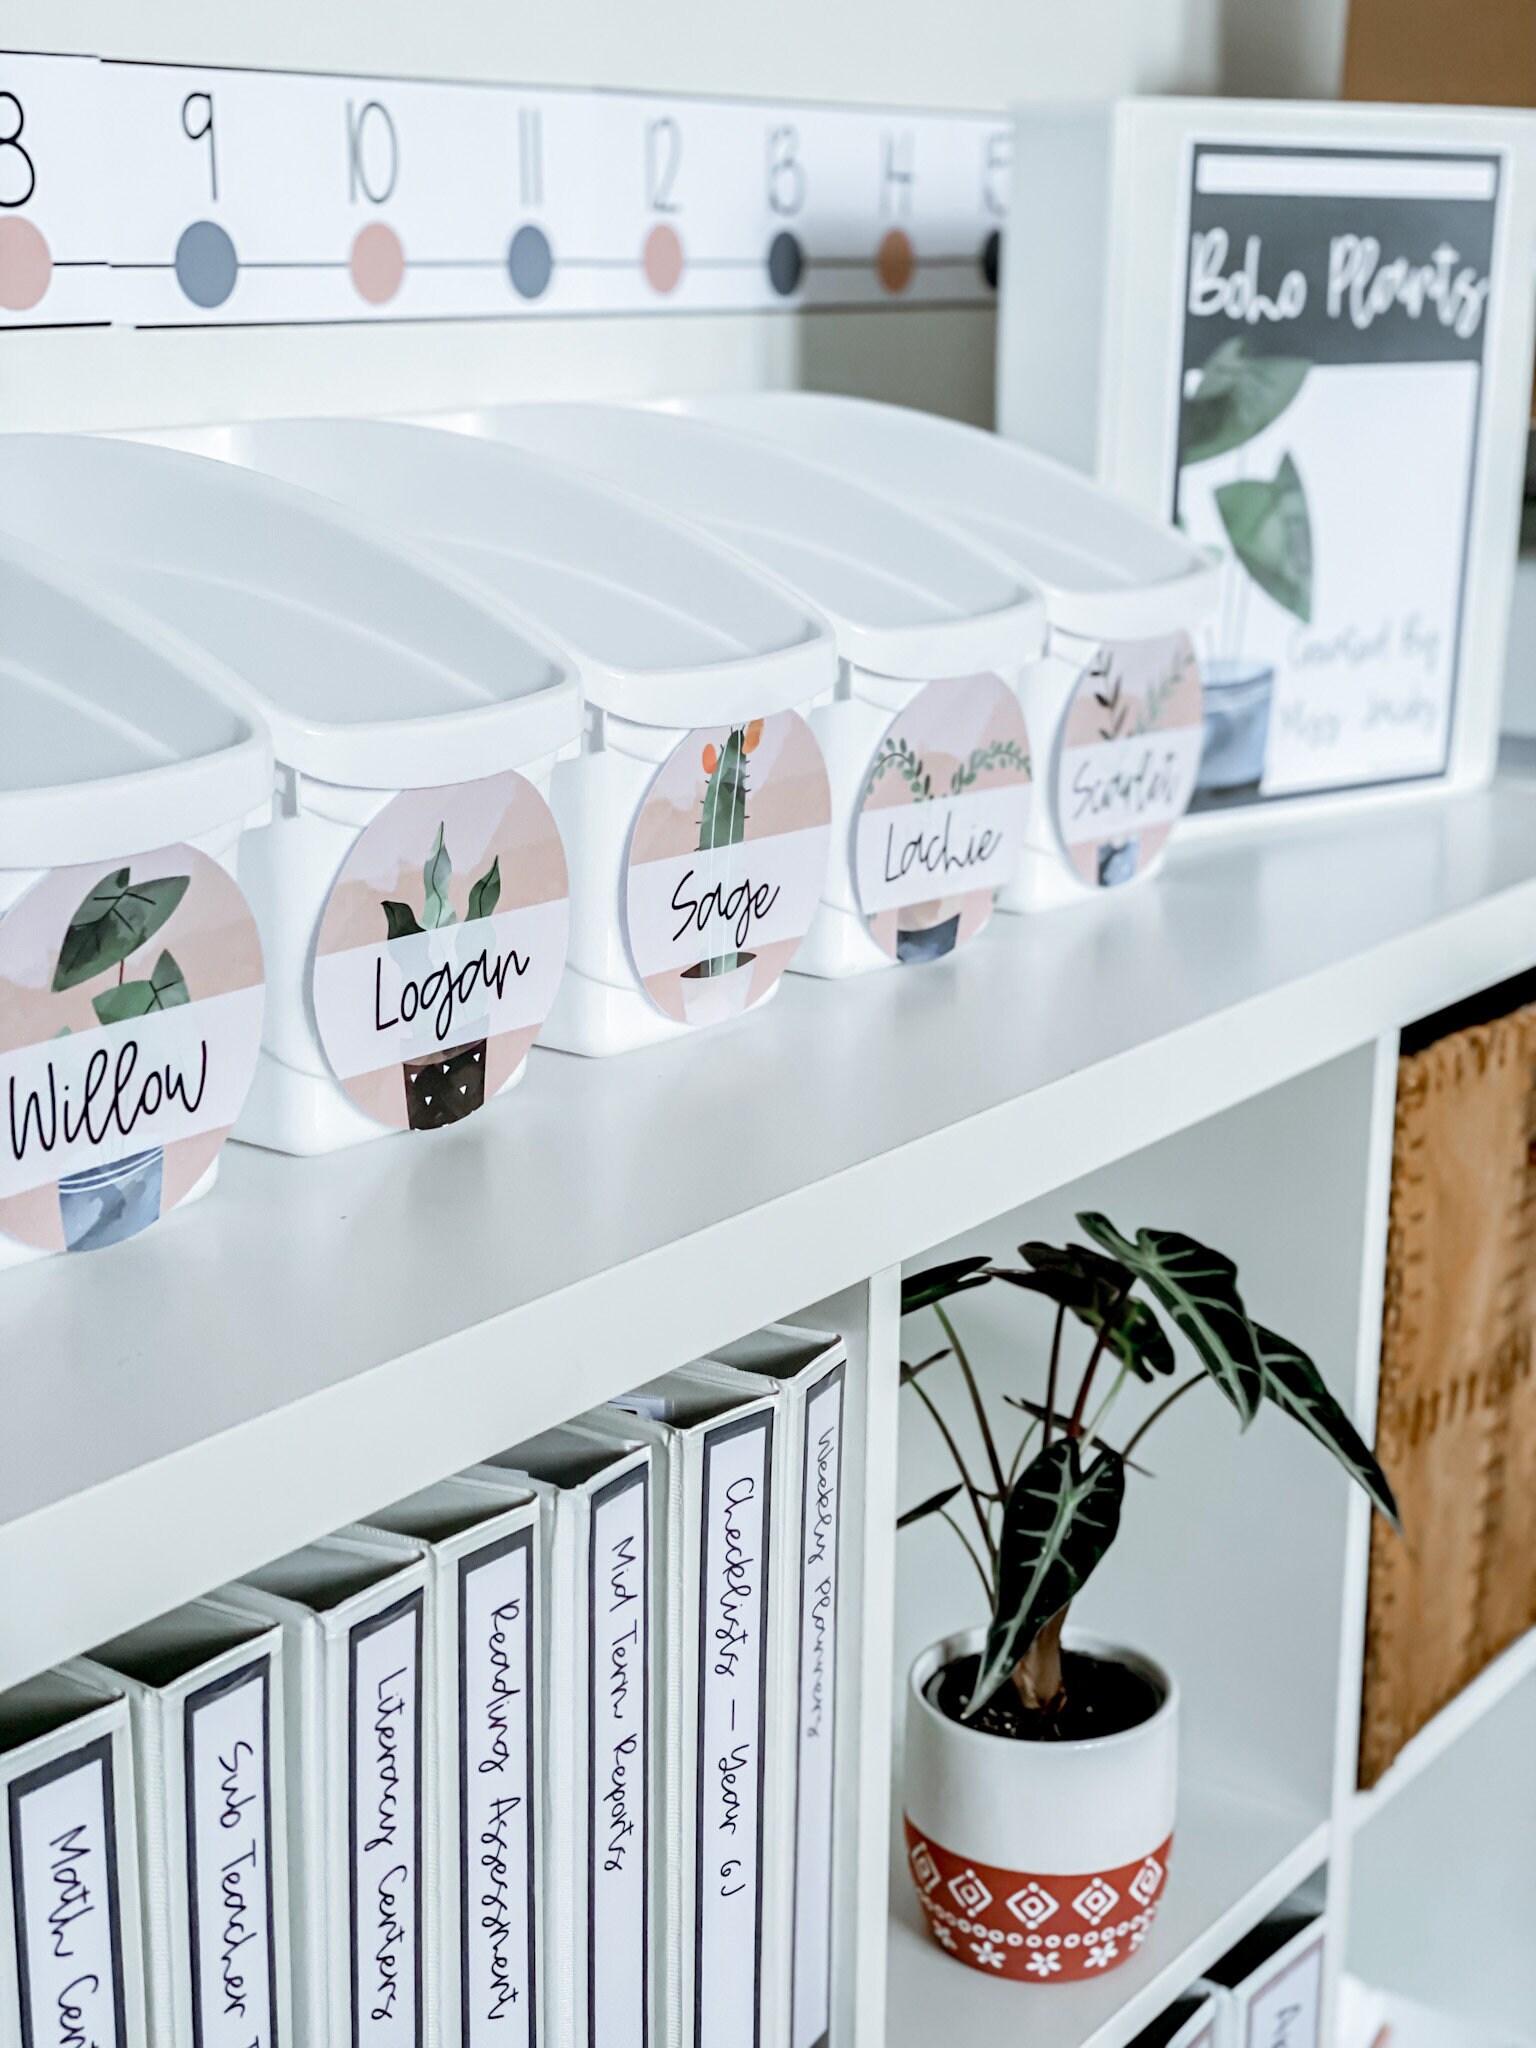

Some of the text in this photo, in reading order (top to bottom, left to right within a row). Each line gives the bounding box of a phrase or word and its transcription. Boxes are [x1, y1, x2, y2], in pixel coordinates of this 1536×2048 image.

[181, 91, 218, 202] 9
[345, 98, 400, 206] 10
[518, 107, 544, 206] 11
[644, 115, 682, 213] 12
[1188, 226, 1490, 339] Boho Plants
[671, 870, 780, 948] Sage
[885, 811, 1001, 883] Lachie
[376, 949, 530, 1040] Logan
[9, 1040, 207, 1160] Willow
[808, 1427, 836, 1565] Weekly
[715, 1477, 754, 1677] Checklists
[603, 1536, 638, 1871] Mid Term Reports
[364, 1667, 407, 2020] Literacy Centers
[478, 1599, 521, 2020] Reading Assessment
[718, 1744, 751, 1835] Year
[48, 1824, 95, 1958] Math
[218, 1741, 257, 2019] Sub Teacher
